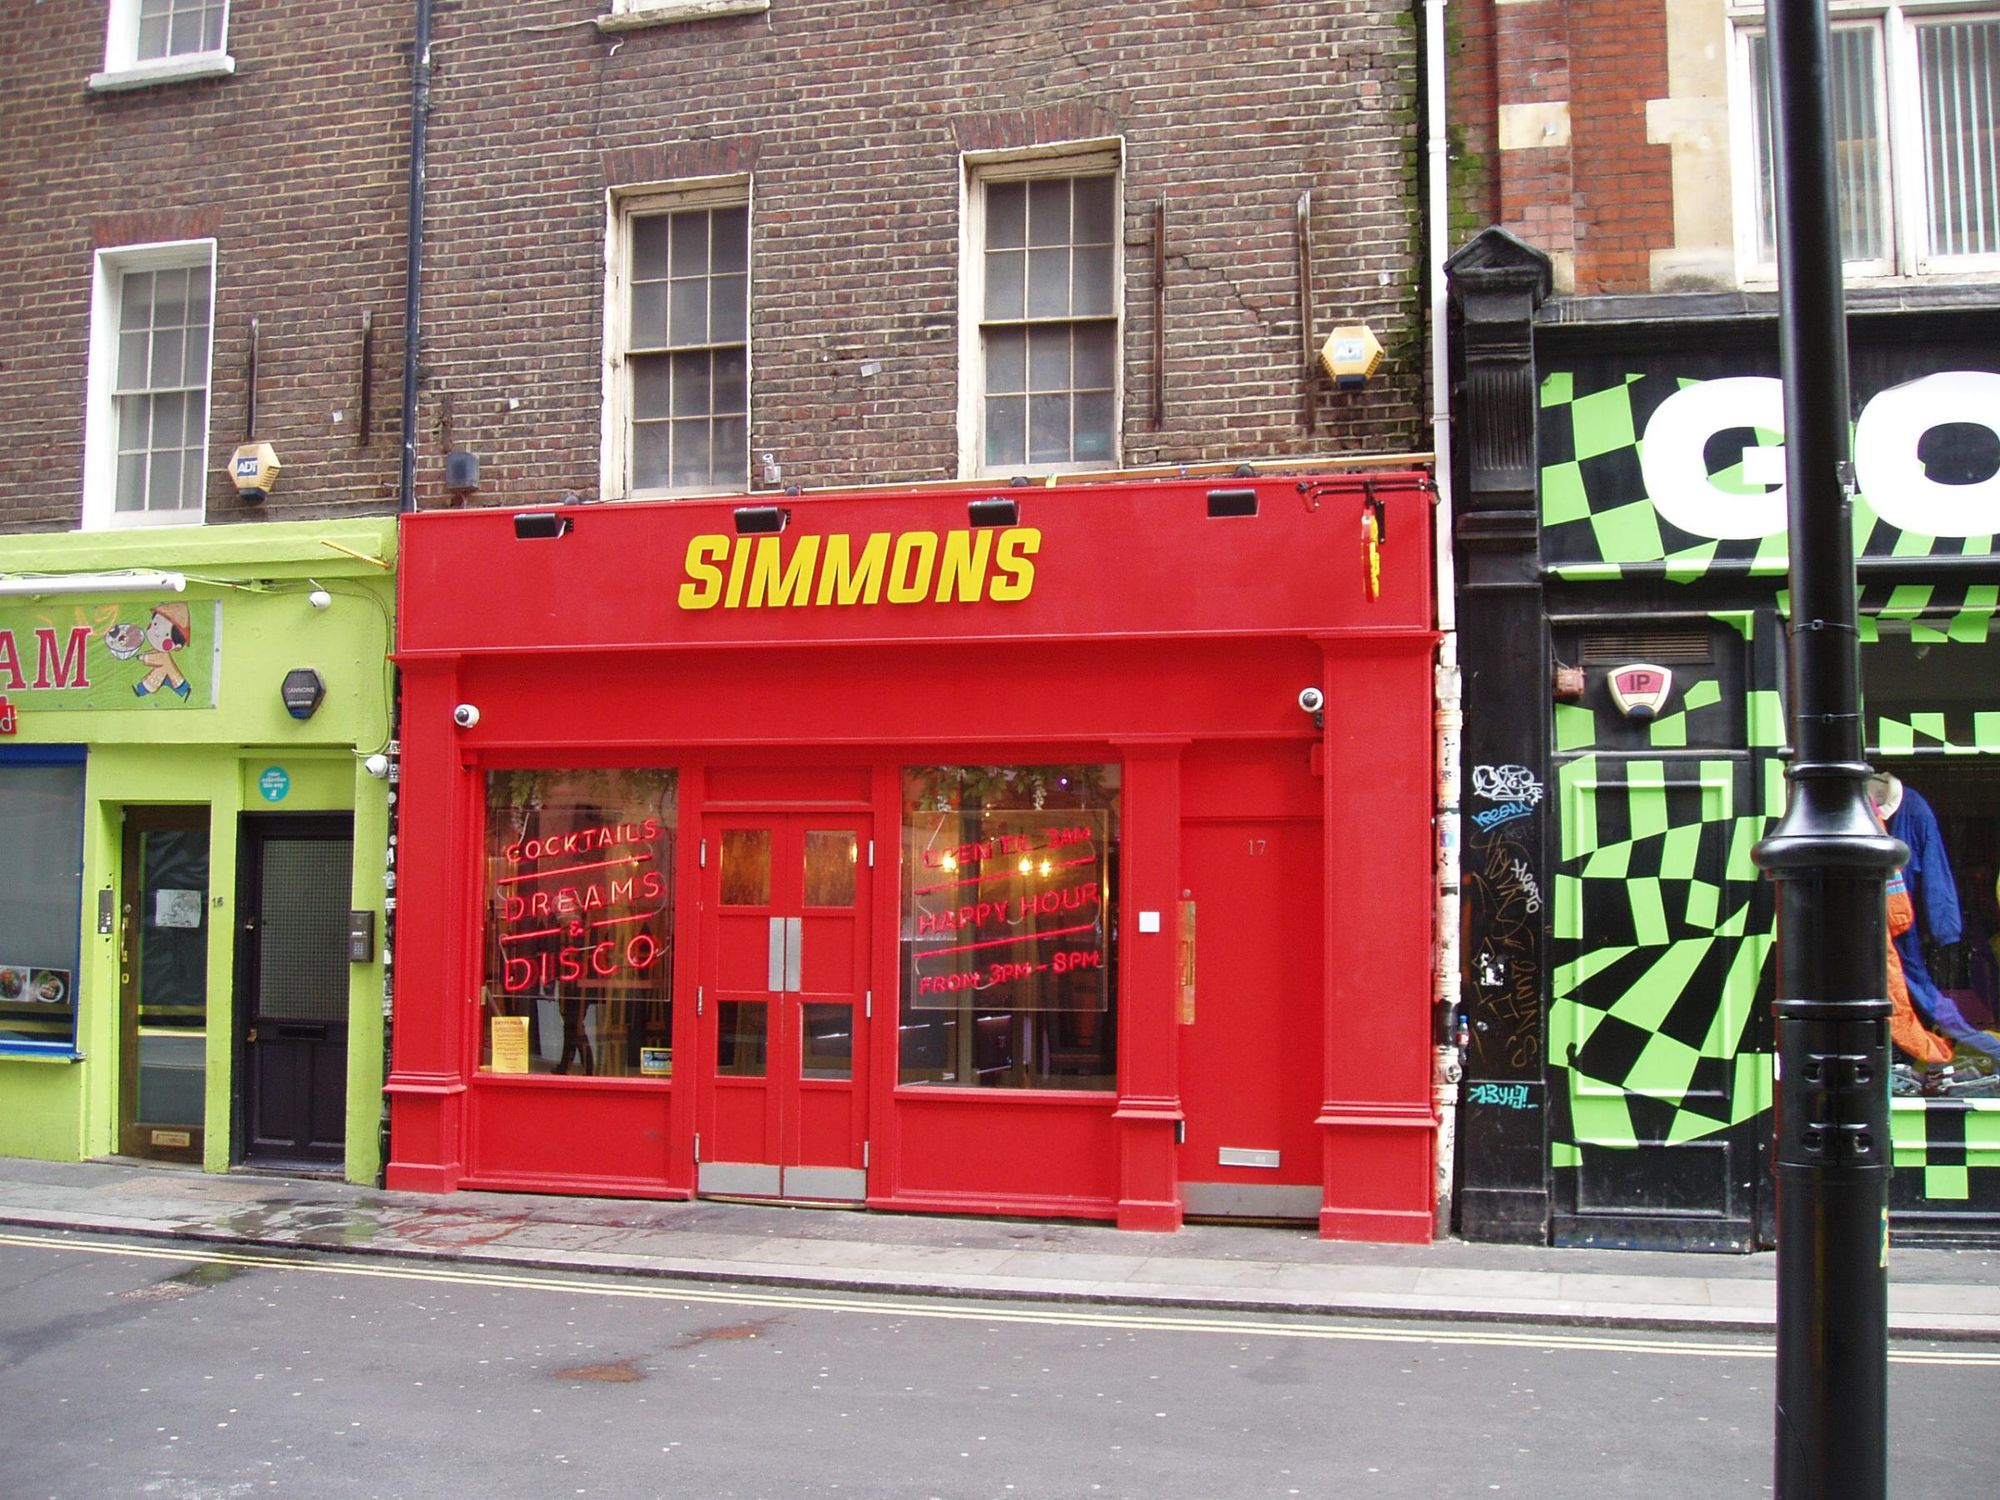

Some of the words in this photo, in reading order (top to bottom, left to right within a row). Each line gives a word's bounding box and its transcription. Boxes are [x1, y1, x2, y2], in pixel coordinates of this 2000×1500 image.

[238, 460, 259, 474] ADT
[677, 527, 1042, 610] SIMMONS
[1629, 674, 1650, 691] IP
[507, 819, 658, 863] COCKTAILS
[1248, 839, 1266, 856] 17
[506, 872, 660, 921] DREAMS
[918, 902, 1008, 935] HAPPY
[1021, 883, 1098, 918] HOUR
[506, 935, 656, 990] DISCO
[919, 972, 980, 995] FROM
[990, 962, 1032, 985] 3PM
[1054, 952, 1099, 974] 8PM
